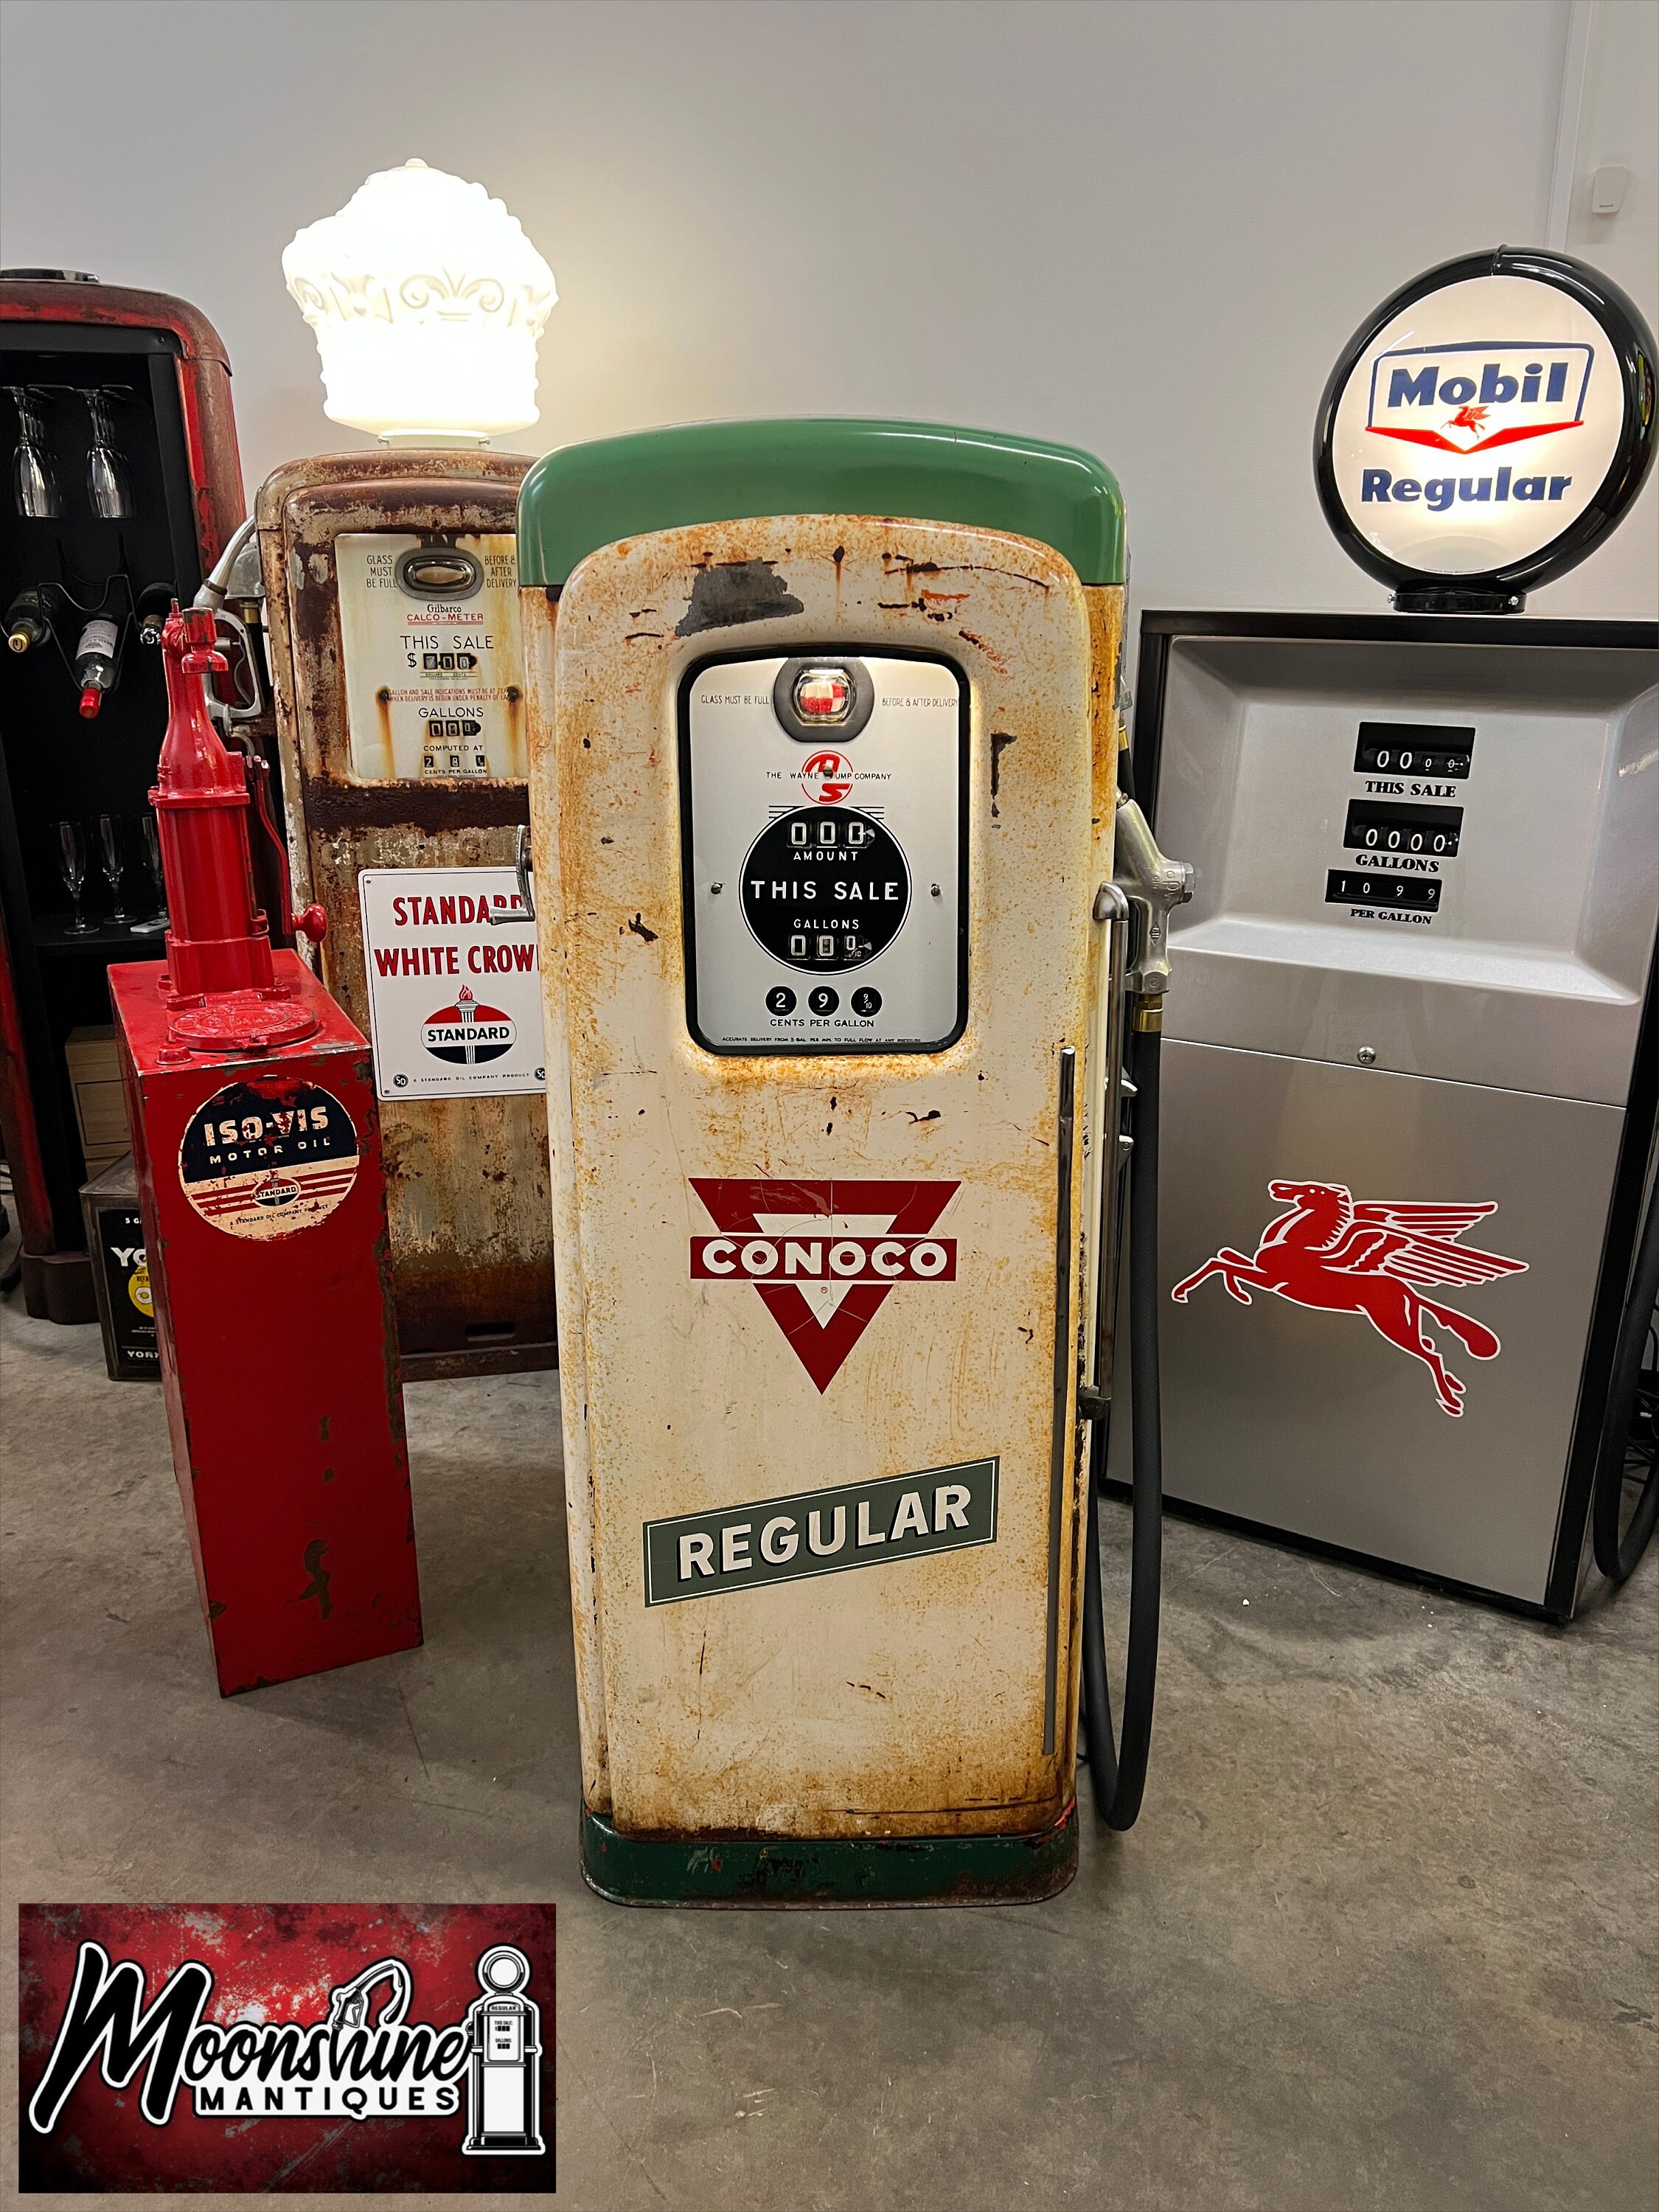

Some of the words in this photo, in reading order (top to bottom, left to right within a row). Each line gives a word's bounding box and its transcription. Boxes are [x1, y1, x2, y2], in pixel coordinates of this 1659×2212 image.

[1387, 361, 1569, 408] Mobil
[1361, 466, 1573, 512] Regular
[366, 555, 392, 565] GLASS
[484, 555, 507, 566] BEFORE
[370, 567, 392, 577] MUST
[490, 567, 512, 577] AFTER
[366, 578, 376, 588] BE
[380, 578, 397, 588] FULL
[487, 578, 516, 588] DELIVERY
[427, 604, 462, 613] Gilbarco
[400, 636, 439, 650] THIS
[453, 636, 494, 650] SALE
[407, 653, 417, 667] $
[700, 695, 722, 705] GLASS
[725, 695, 740, 705] MUST
[744, 695, 751, 705] BE
[754, 695, 769, 705] FULL
[882, 698, 904, 706] BEFORE
[912, 698, 931, 707] AFTER
[932, 698, 959, 707] DELIVERY
[418, 707, 484, 717] GALLONS
[766, 771, 782, 779] THE
[1366, 780, 1405, 795] THIS
[1410, 783, 1457, 798] SALE
[793, 851, 858, 861] AMOUNT
[1355, 854, 1439, 872] GALLONS
[751, 880, 817, 900] THIS
[834, 881, 899, 900] SALE
[1350, 908, 1374, 919] PER
[1378, 911, 1432, 925] GALLON
[793, 919, 859, 930] GALLONS
[374, 947, 460, 977] WHITE
[467, 945, 539, 975] CROW
[776, 992, 786, 1008] 2
[818, 992, 828, 1008] 9
[770, 1019, 805, 1027] CENTS
[810, 1019, 830, 1027] PER
[834, 1019, 874, 1028] GALLON
[428, 1026, 509, 1042] STANDARD
[204, 1106, 329, 1147] ISO-VIS
[209, 1145, 283, 1164] MOTOR
[298, 1138, 330, 1150] OIL
[256, 1186, 296, 1199] STANDARD
[111, 1247, 147, 1267] YO
[702, 1239, 947, 1277] CONOCO
[678, 1484, 973, 1582] REGULAR
